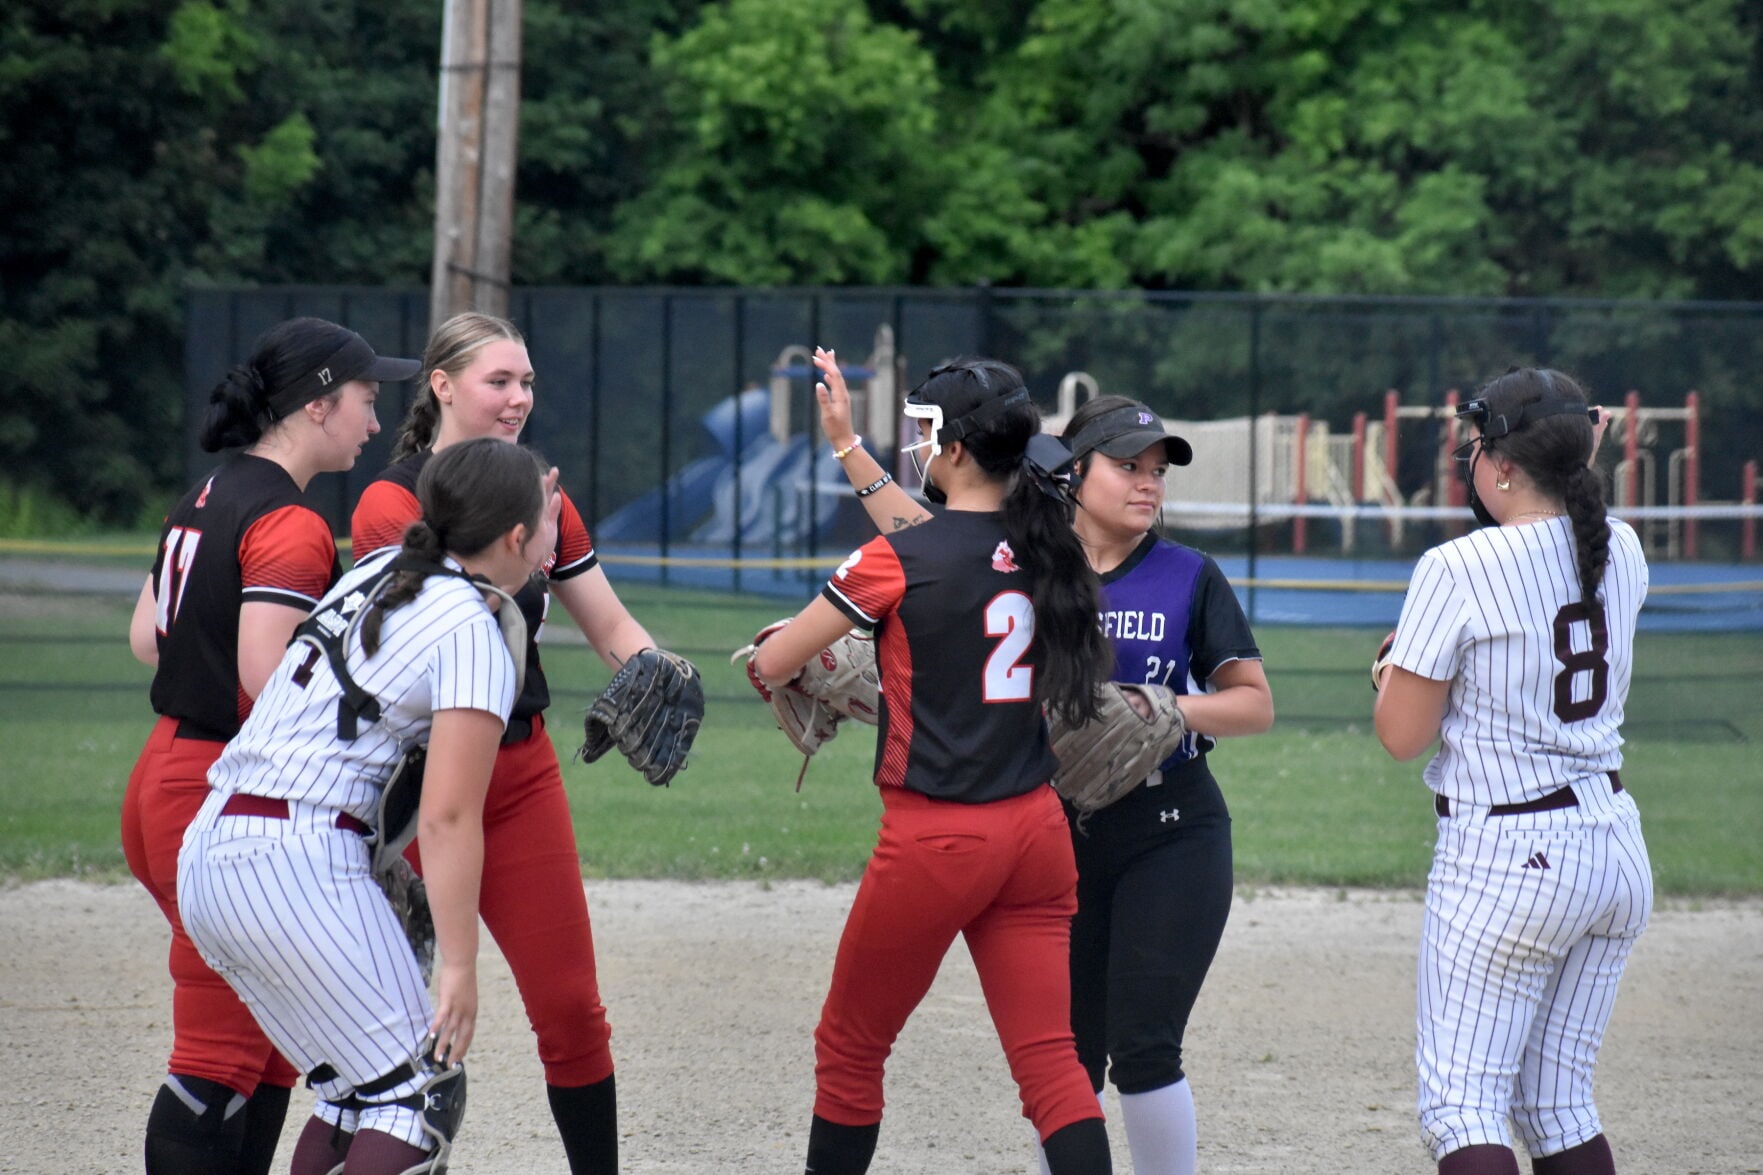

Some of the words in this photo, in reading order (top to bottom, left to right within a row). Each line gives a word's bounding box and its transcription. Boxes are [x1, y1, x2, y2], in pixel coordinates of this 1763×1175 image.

[317, 367, 333, 386] 17
[1138, 412, 1153, 425] P
[155, 525, 203, 637] 17
[835, 549, 863, 581] 2
[982, 589, 1036, 704] 2
[1552, 601, 1609, 724] 8
[1145, 655, 1176, 686] 21
